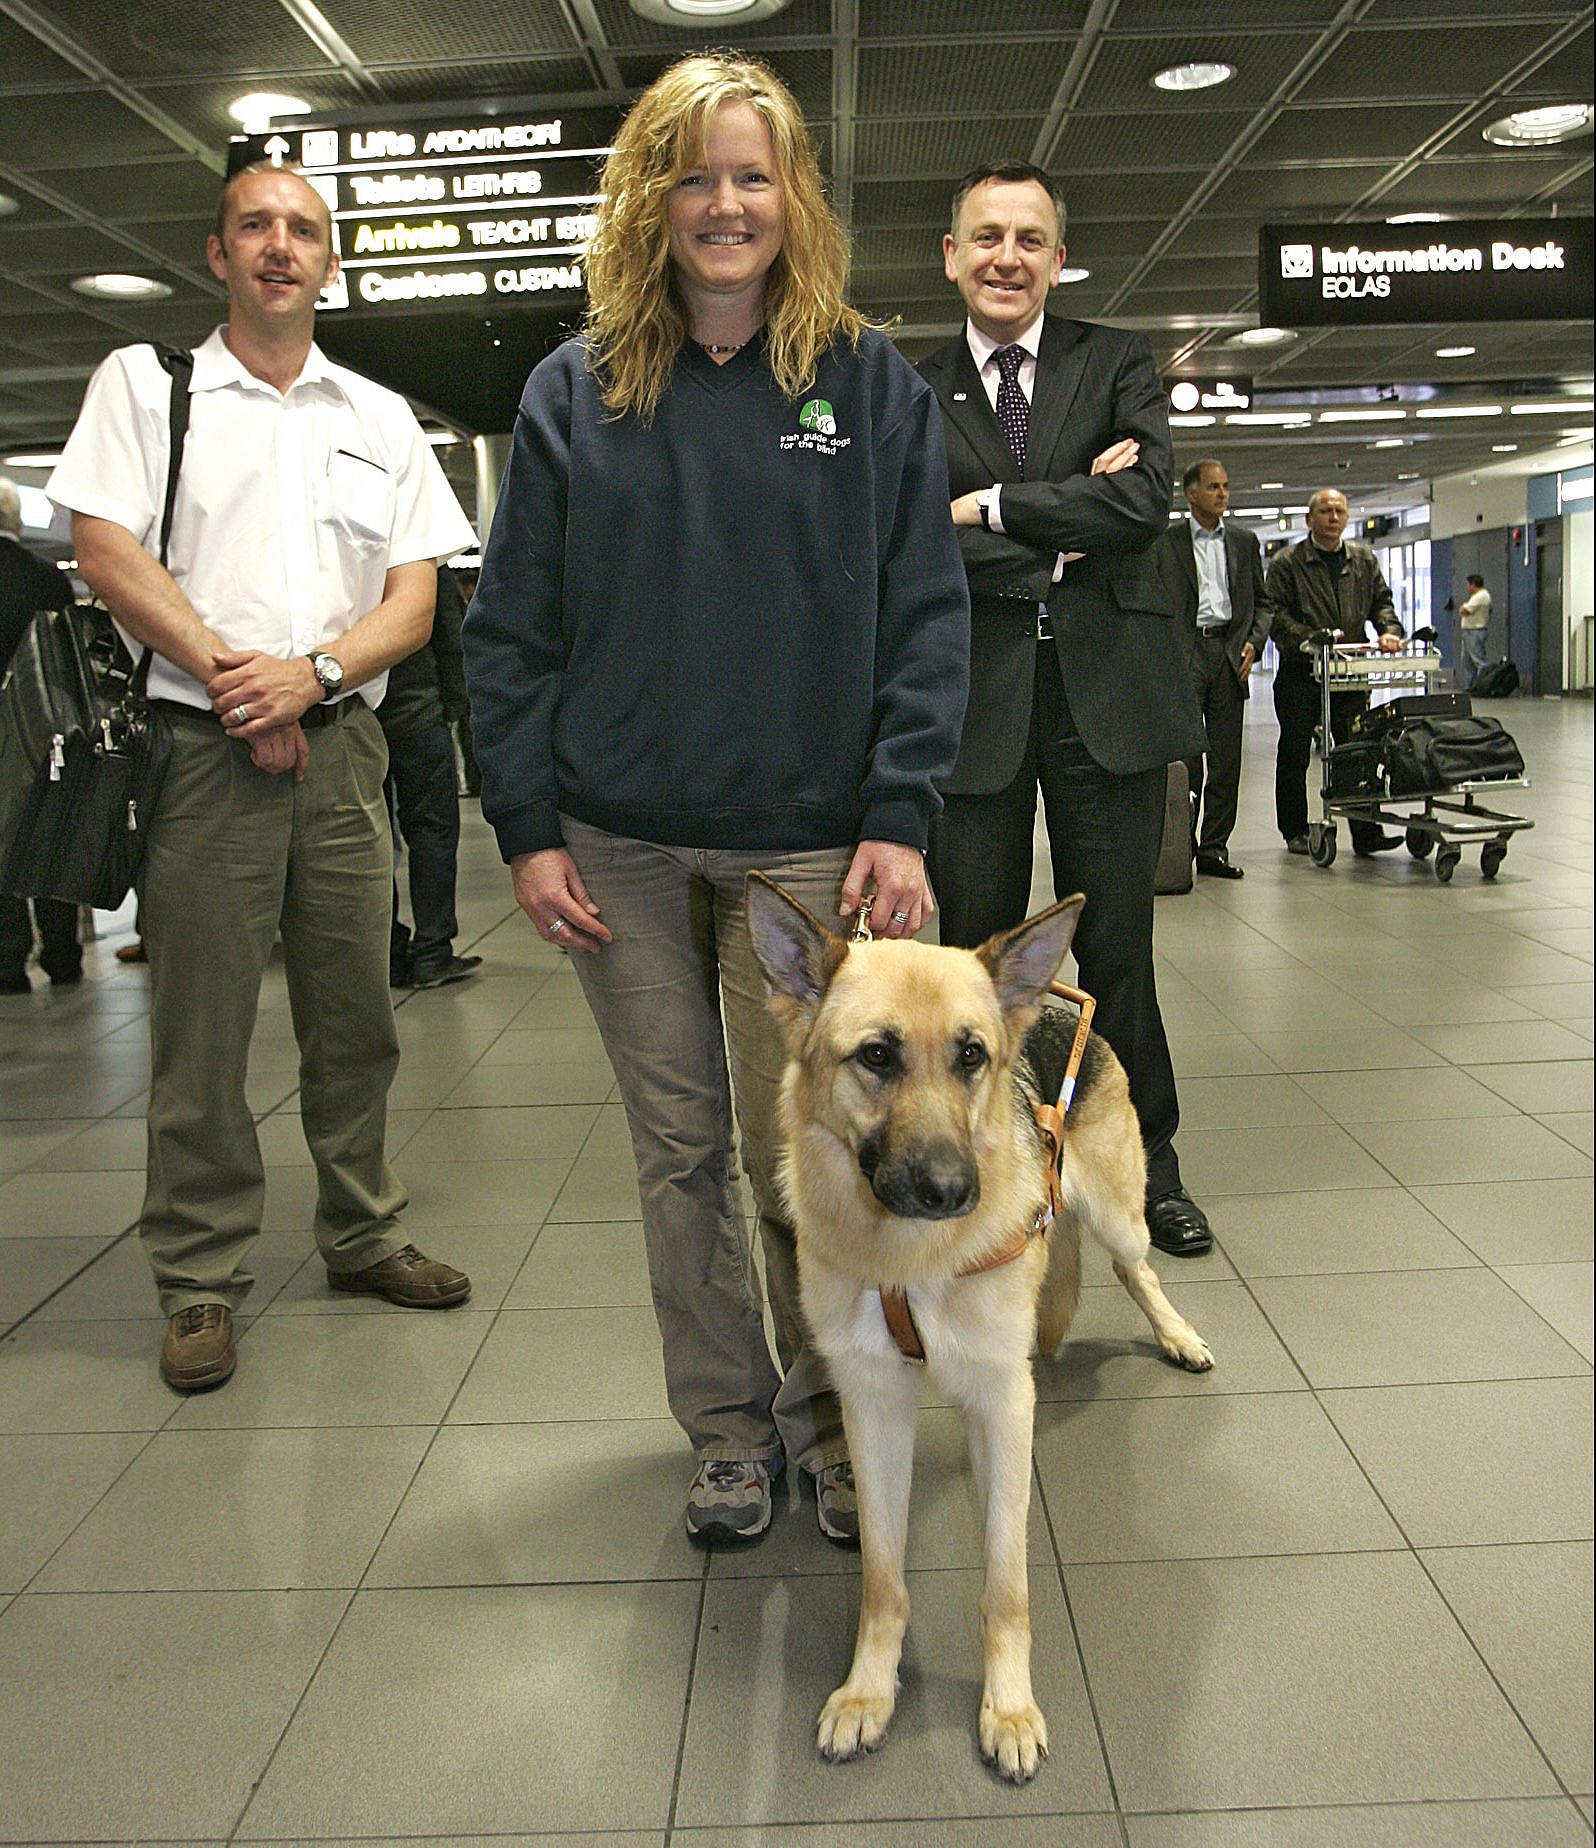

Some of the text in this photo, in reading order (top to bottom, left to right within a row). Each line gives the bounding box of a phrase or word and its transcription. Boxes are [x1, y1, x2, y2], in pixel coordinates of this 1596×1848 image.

[350, 131, 416, 159] Lifts
[350, 174, 445, 204] Toilets
[354, 221, 460, 253] Arrivals
[467, 218, 551, 245] TEACHT
[1321, 242, 1564, 274] Information Desk
[359, 266, 582, 302] Customs CUSTAM
[1321, 275, 1391, 298] EOLAS
[780, 440, 837, 456] for the blind
[803, 433, 828, 443] guide
[830, 437, 851, 448] dogs
